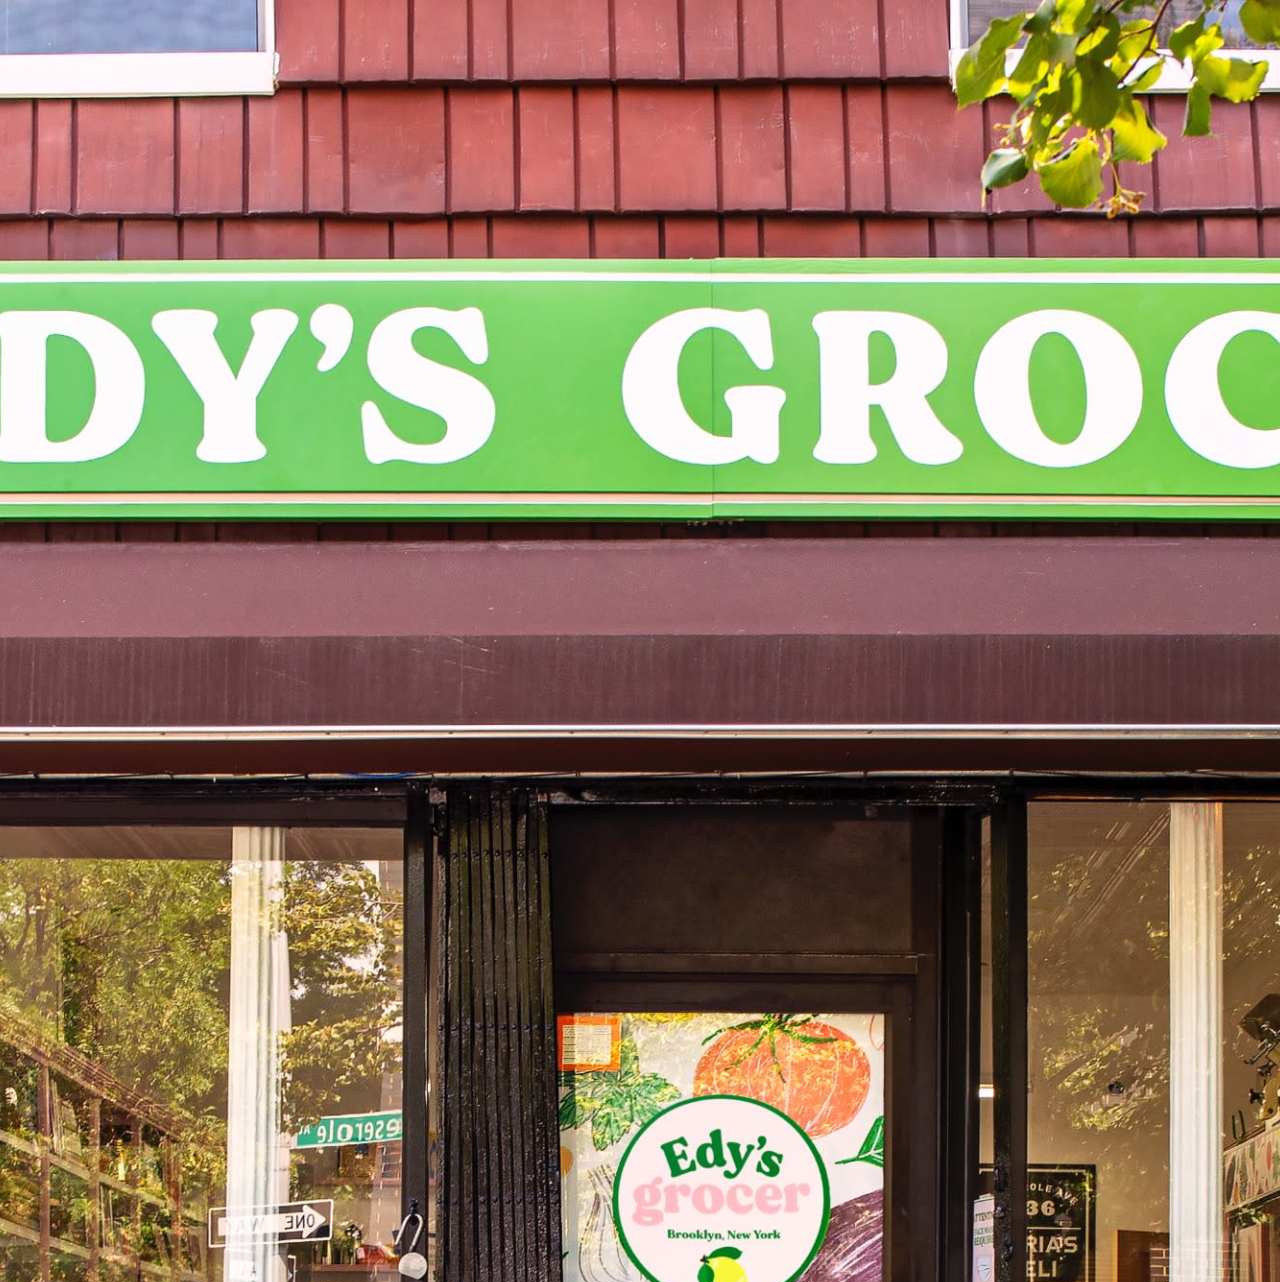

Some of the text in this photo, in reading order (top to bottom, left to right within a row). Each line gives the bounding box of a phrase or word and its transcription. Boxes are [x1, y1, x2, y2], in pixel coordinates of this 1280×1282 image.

[660, 1129, 784, 1179] Edy's
[632, 1176, 810, 1227] grocer
[1026, 1200, 1056, 1216] 36
[667, 1229, 781, 1242] Brooklyn, New York
[1025, 1260, 1058, 1278] ELI
